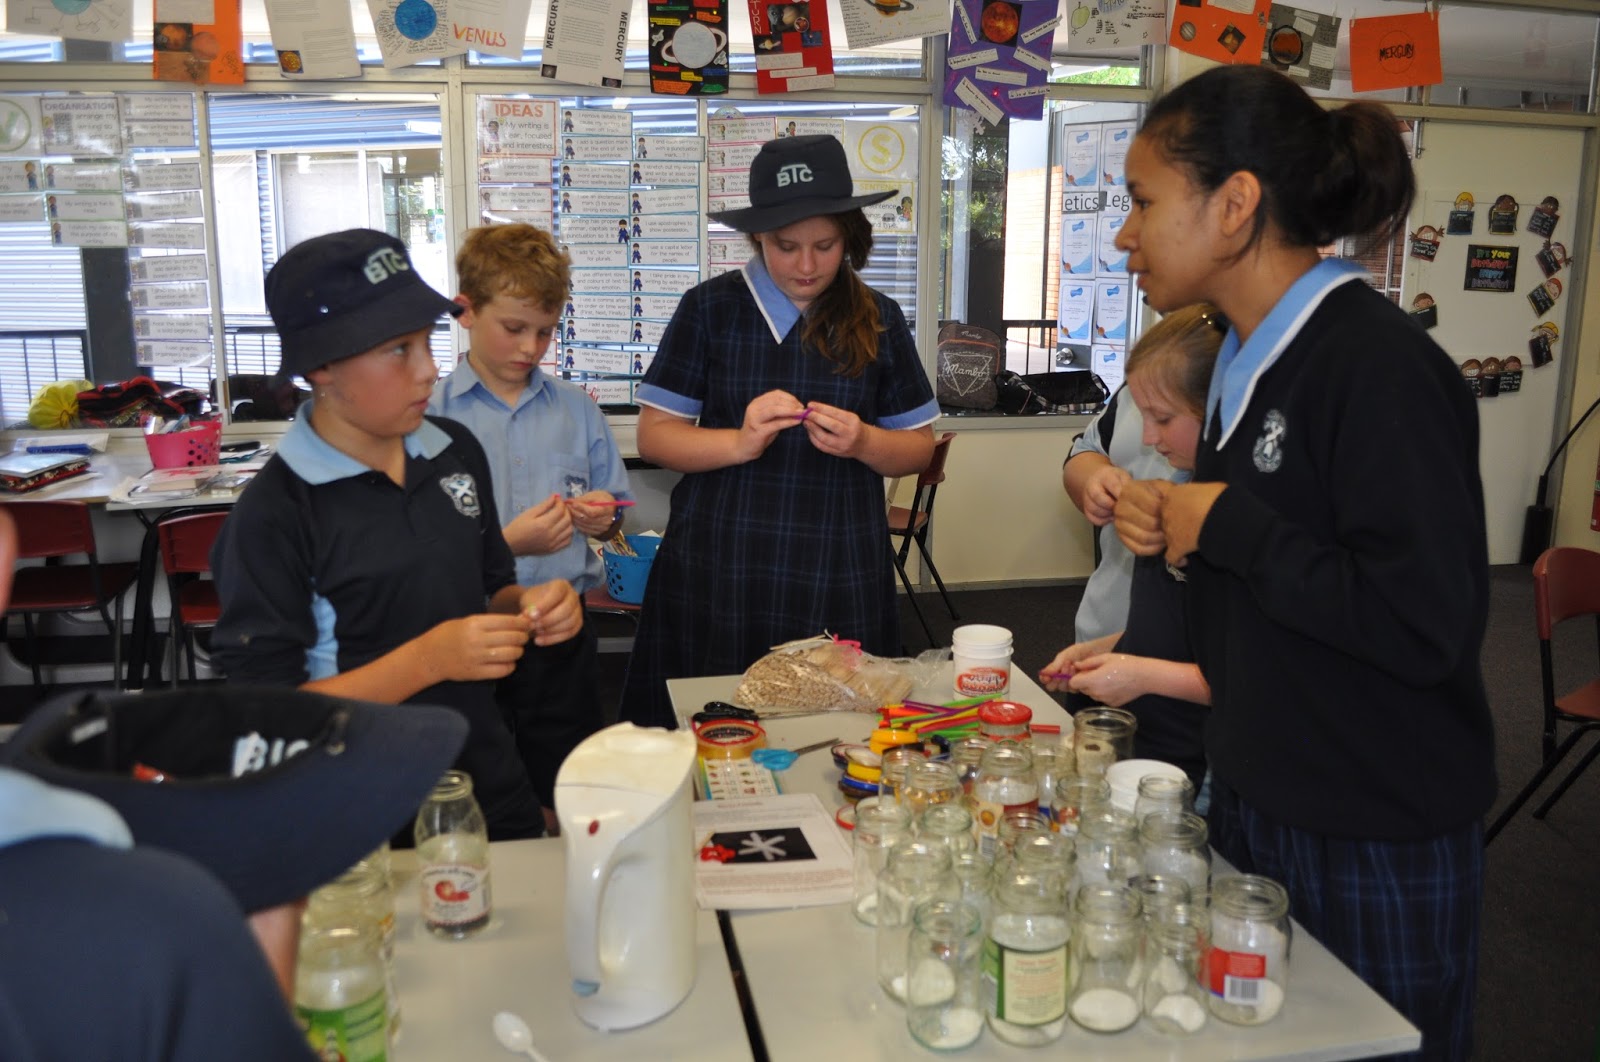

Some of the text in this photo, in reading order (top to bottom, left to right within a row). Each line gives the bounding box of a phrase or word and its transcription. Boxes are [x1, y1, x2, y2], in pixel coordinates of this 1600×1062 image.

[546, 0, 559, 49] MERCURY
[453, 22, 507, 48] VENUS
[615, 11, 629, 63] MERCURY
[45, 102, 114, 110] ORGANISATION
[495, 104, 543, 118] IDEAS
[506, 122, 542, 130] My writing
[517, 142, 553, 151] interesting.
[871, 134, 891, 166] S
[776, 164, 814, 187] BTC
[1064, 194, 1099, 211] etics
[363, 247, 410, 285] BTC
[961, 330, 982, 339] Mambo
[946, 363, 986, 378] Mambo
